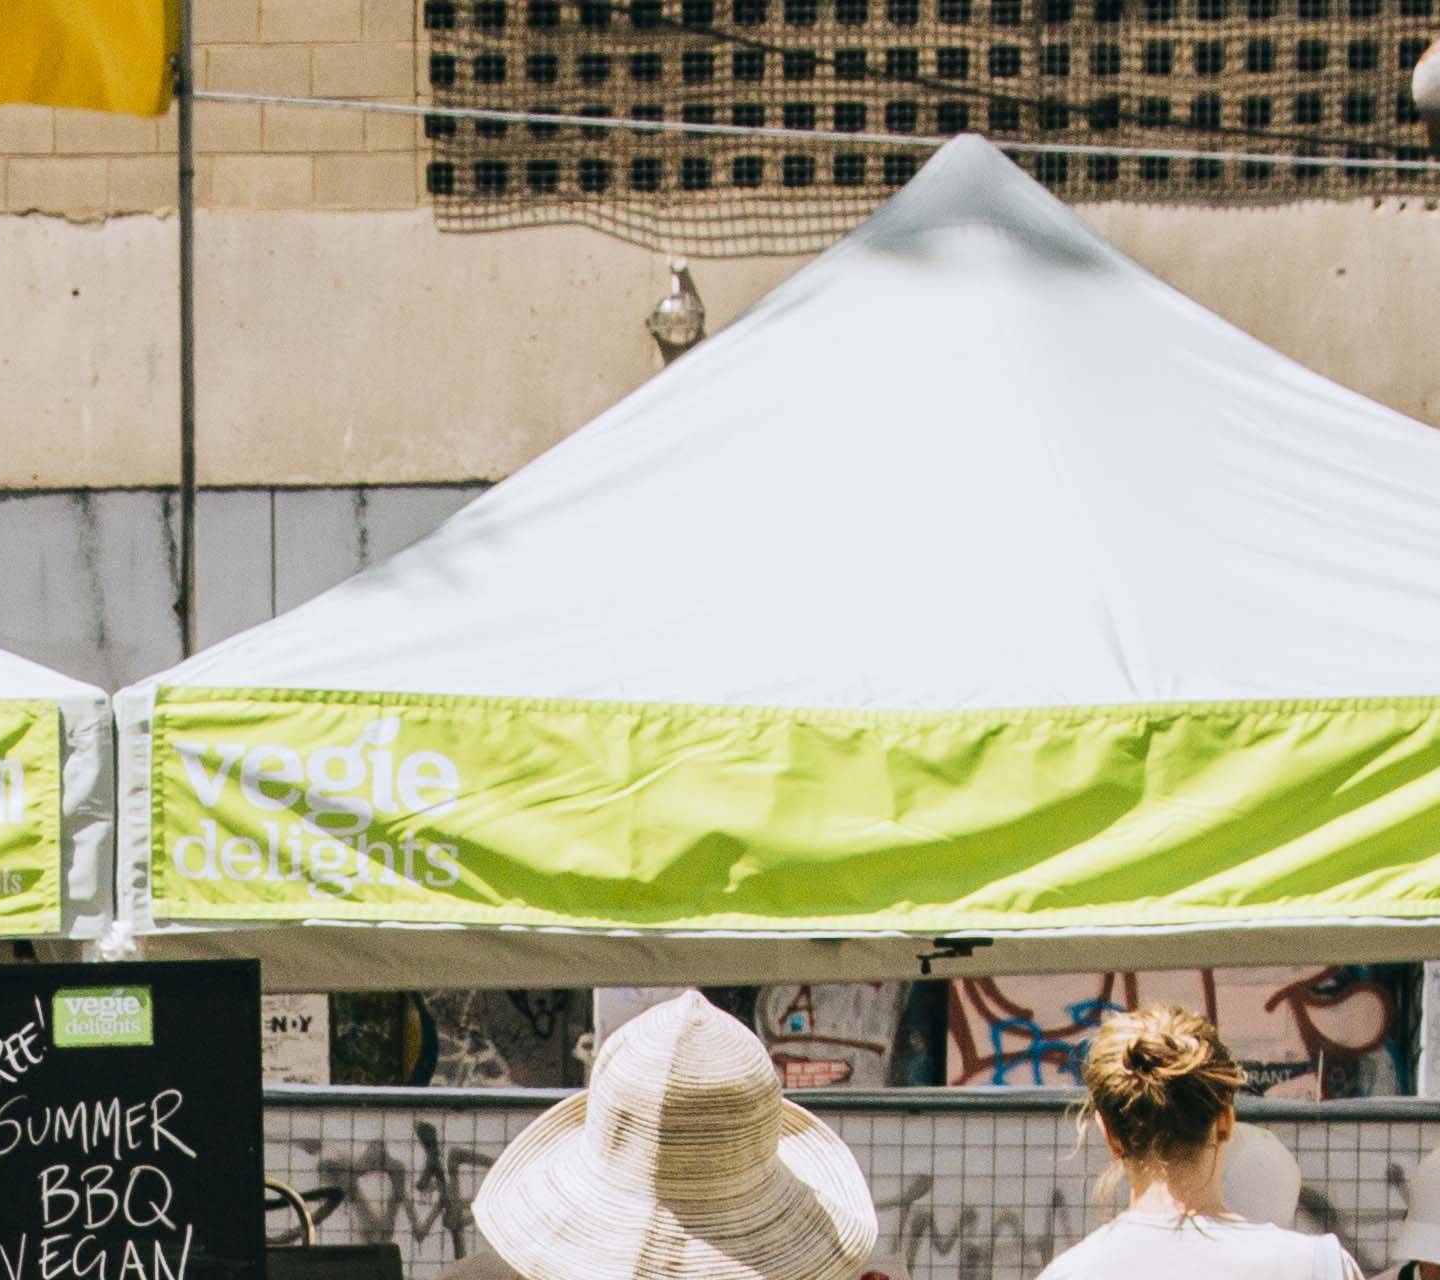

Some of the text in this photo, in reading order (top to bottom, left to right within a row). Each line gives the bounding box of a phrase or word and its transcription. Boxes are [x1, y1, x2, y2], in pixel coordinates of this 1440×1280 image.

[173, 717, 460, 835] vegie
[172, 819, 460, 900] delights
[64, 987, 141, 1020] vegie
[64, 1017, 142, 1039] delights
[38, 1164, 177, 1231] BBQ
